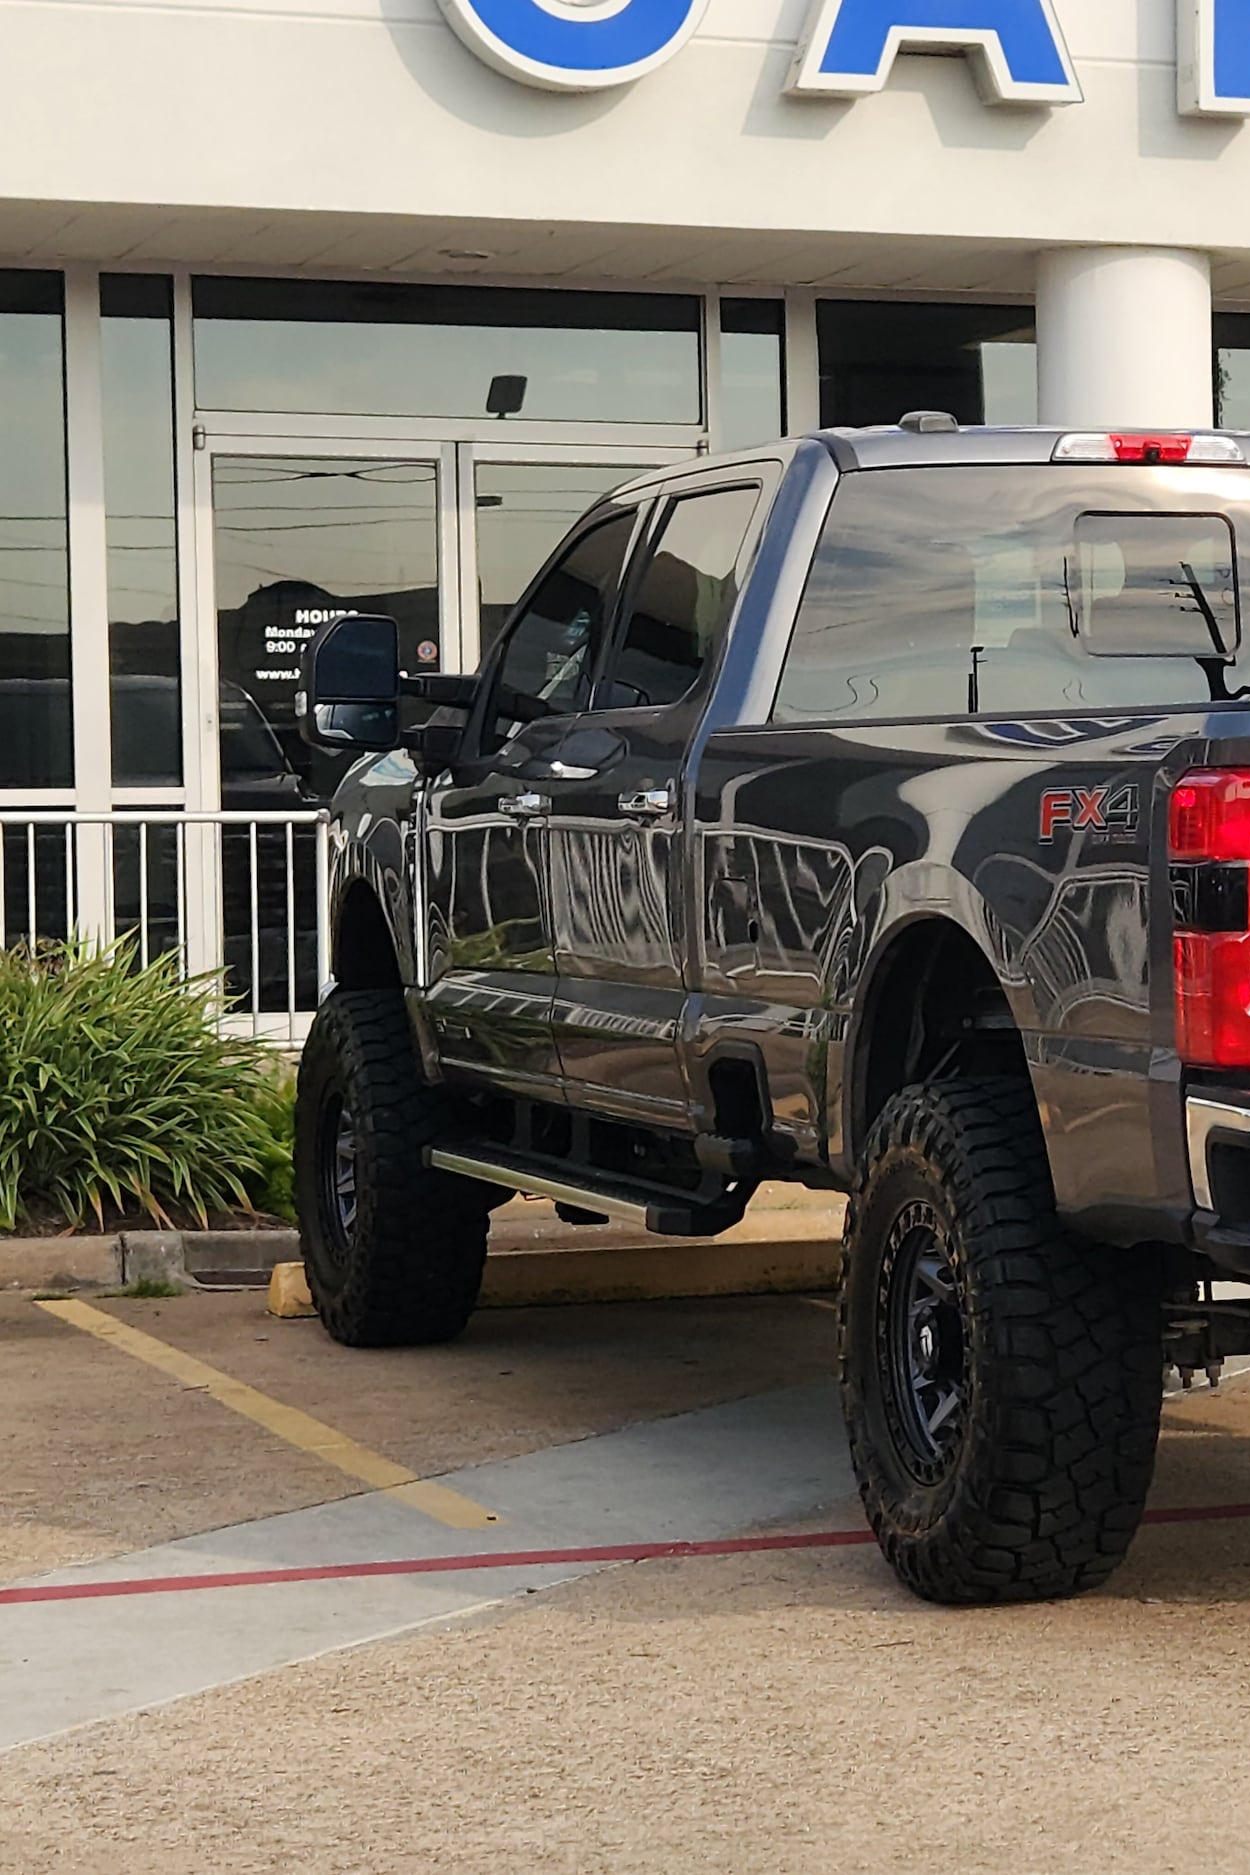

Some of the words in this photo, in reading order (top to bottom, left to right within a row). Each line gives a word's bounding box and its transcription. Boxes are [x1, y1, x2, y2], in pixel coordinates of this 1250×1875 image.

[295, 609, 359, 624] HOU
[266, 641, 297, 653] 9:00
[1038, 784, 1140, 845] FX4
